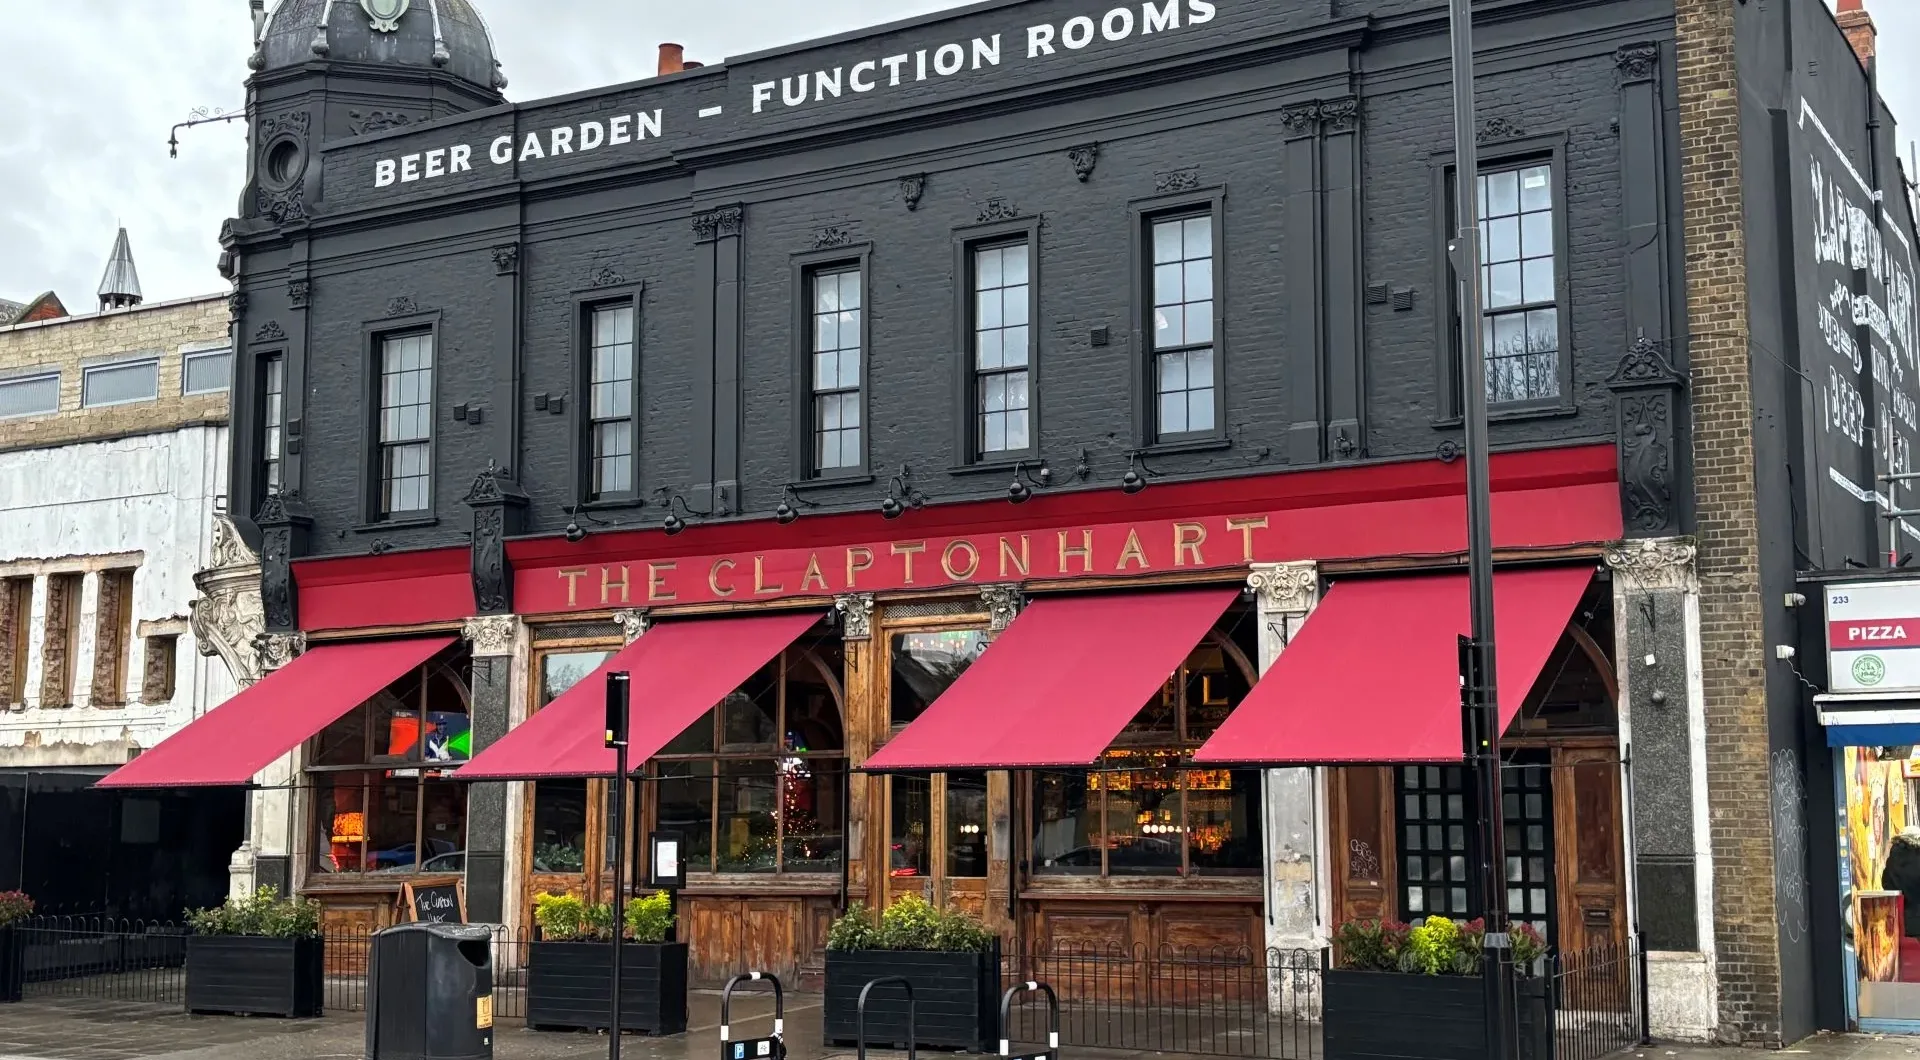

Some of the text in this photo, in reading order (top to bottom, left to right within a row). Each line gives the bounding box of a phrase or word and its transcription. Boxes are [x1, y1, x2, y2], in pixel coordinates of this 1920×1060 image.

[374, 144, 472, 188] BEER
[489, 108, 663, 165] GARDEN
[752, 33, 1001, 114] FUNCTION
[1026, 0, 1216, 59] ROOMS
[558, 515, 1269, 606] THE CLAPTON HART
[1832, 595, 1849, 604] 233
[1848, 625, 1907, 640] PIZZA
